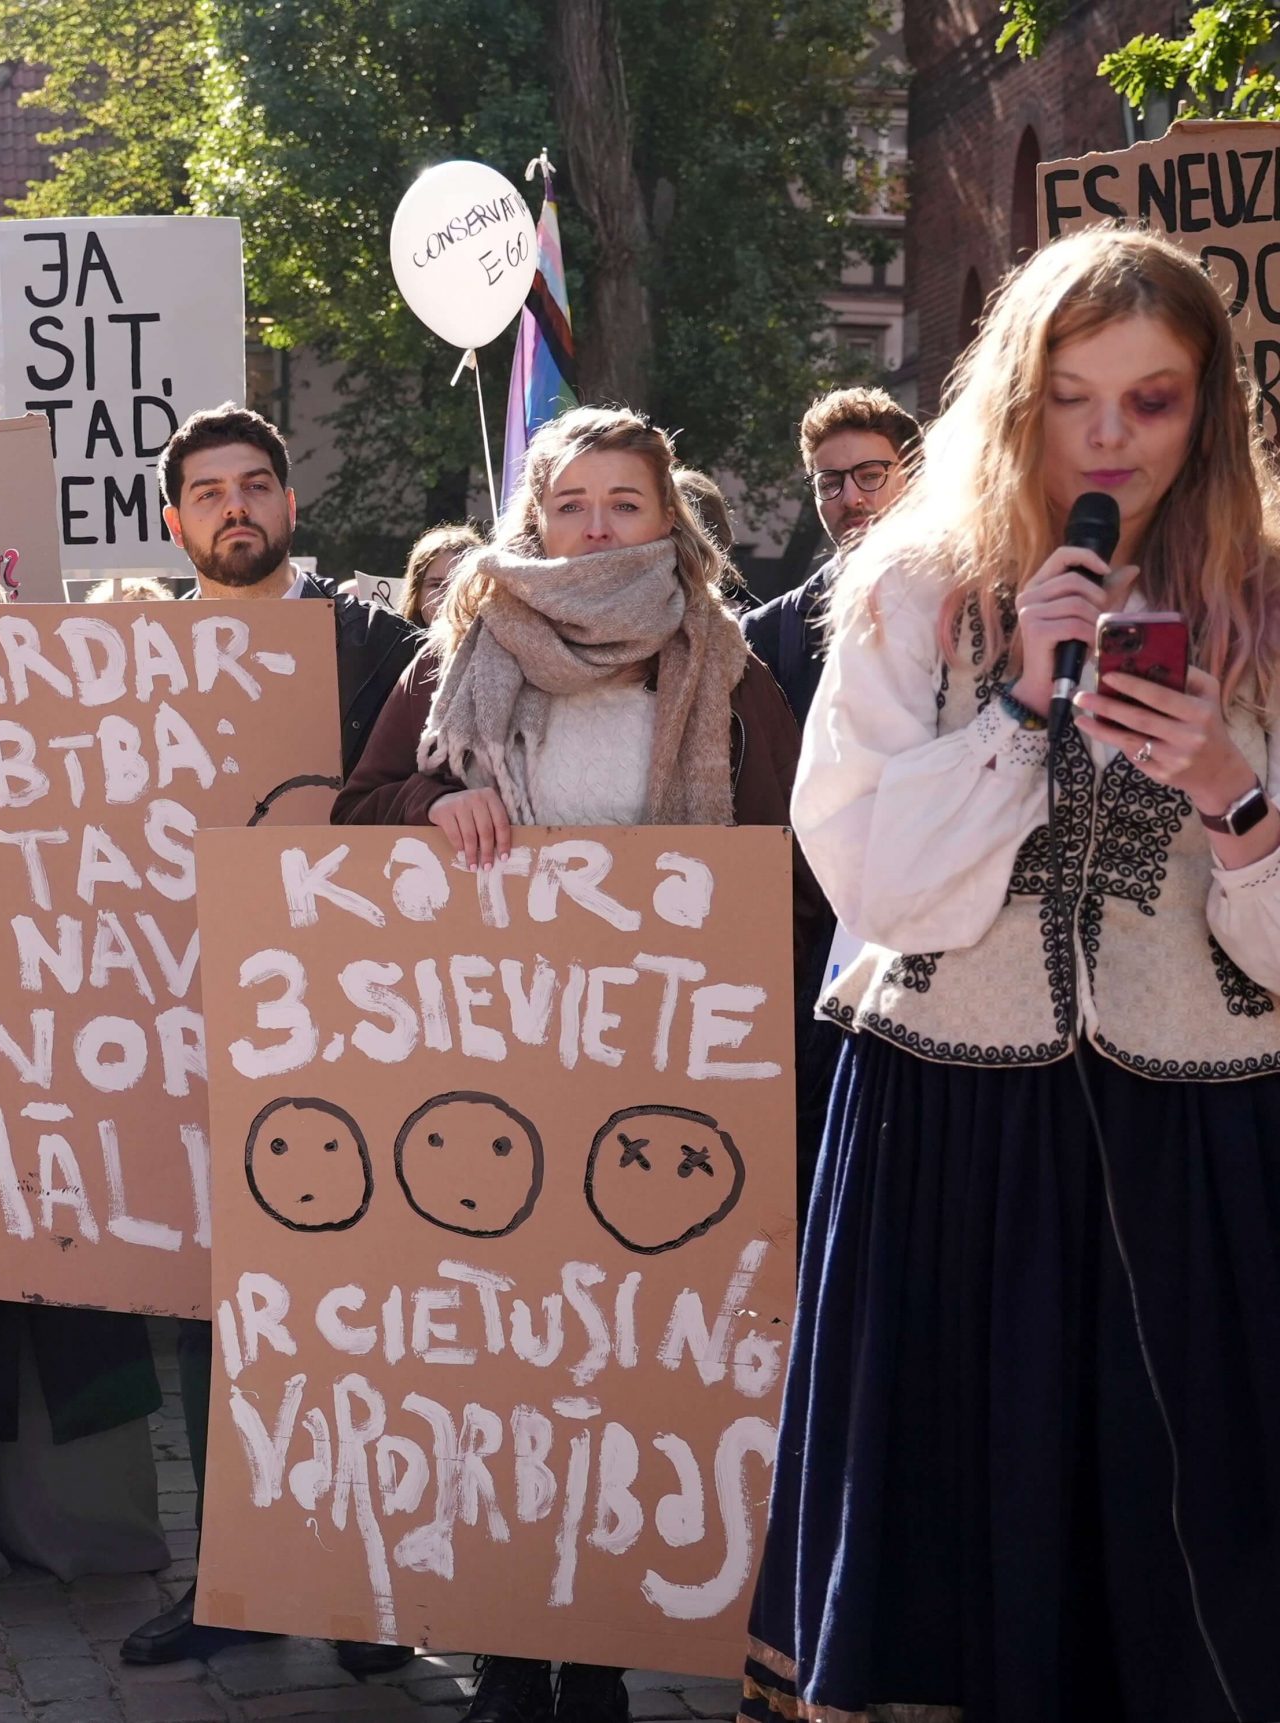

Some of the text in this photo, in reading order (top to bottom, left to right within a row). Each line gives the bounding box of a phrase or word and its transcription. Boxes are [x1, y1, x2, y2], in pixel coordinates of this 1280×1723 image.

[1139, 147, 1280, 233] NEUZ
[24, 231, 124, 307] JA
[478, 231, 528, 286] EGO
[26, 395, 179, 459] TAD
[10, 911, 201, 1004] NAV
[217, 1271, 297, 1380] IR
